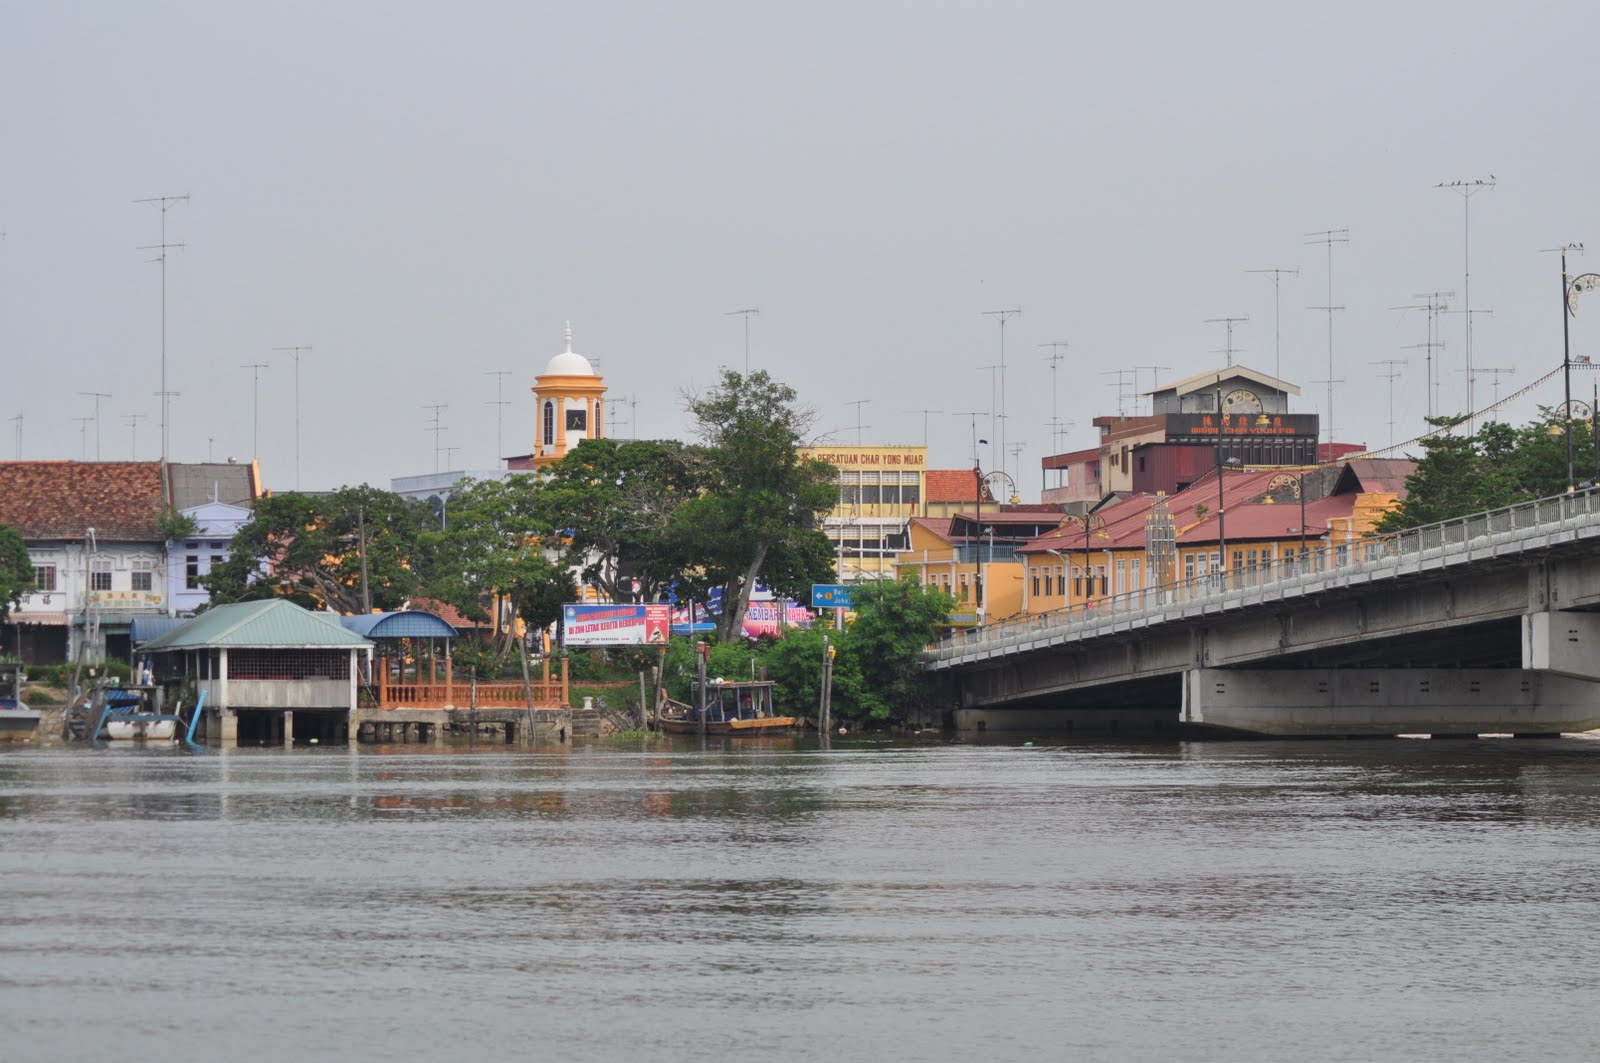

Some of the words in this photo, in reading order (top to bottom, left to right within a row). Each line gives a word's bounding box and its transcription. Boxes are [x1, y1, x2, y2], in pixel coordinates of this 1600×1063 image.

[817, 453, 858, 465] PERSATUAN
[861, 454, 880, 465] CHAR
[883, 454, 901, 465] YONG
[904, 454, 924, 466] MUAR
[585, 623, 600, 633] LETAK
